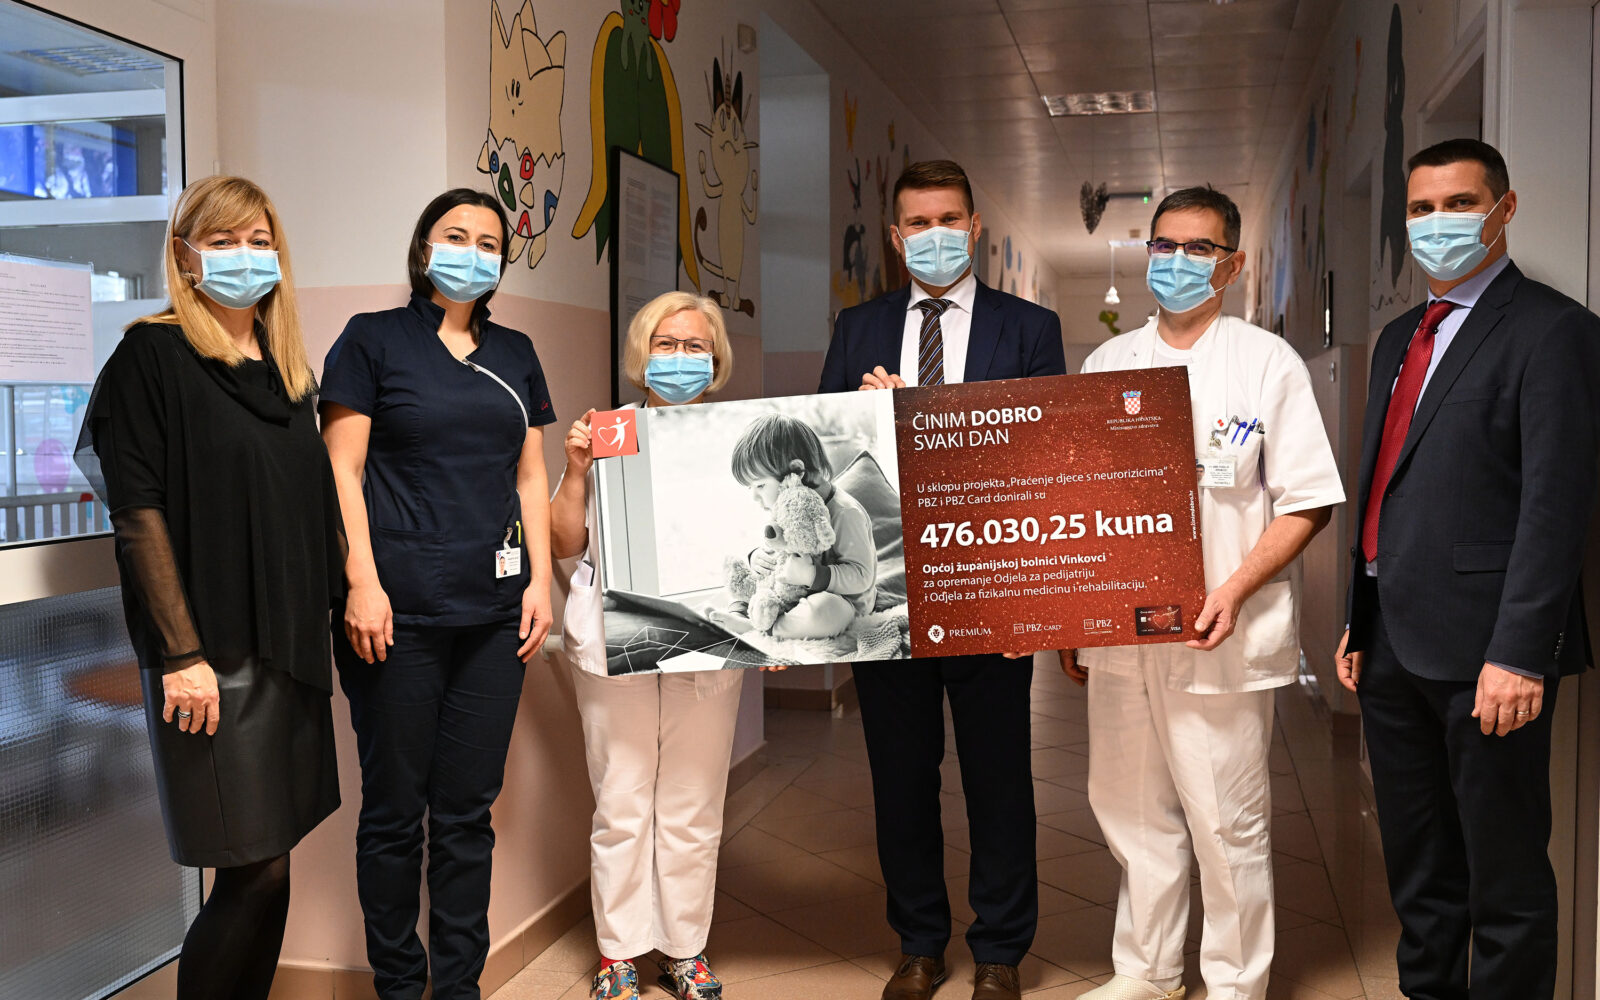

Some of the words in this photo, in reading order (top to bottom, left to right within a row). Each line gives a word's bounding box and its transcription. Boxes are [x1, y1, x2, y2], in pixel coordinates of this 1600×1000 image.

[912, 411, 966, 431] ČINIM
[971, 405, 1042, 427] DOBRO
[914, 431, 964, 451] SVAKI
[969, 428, 1009, 447] DAN
[917, 484, 925, 493] U
[927, 482, 961, 493] sklopu
[963, 479, 1005, 492] projekta
[1007, 475, 1054, 488] „Praćenje
[1056, 473, 1084, 485] djece
[918, 497, 938, 508] PBZ
[945, 495, 965, 506] PBZ
[967, 493, 991, 504] Card
[993, 490, 1032, 503] donirali
[1034, 491, 1046, 500] su
[920, 514, 1086, 548] 476.030,25
[1095, 510, 1173, 537] kuna
[922, 562, 954, 575] Općoj
[956, 558, 1018, 573] županijskoj
[1021, 555, 1058, 567] bolnici
[1059, 552, 1106, 565] Vinkovci
[923, 580, 935, 588] za
[937, 575, 992, 589] opremanje
[994, 572, 1027, 585] Odjela
[1029, 573, 1041, 581] za
[1043, 568, 1095, 582] pedijatriju
[930, 591, 963, 603] Odjela
[965, 592, 976, 600] za
[978, 588, 1020, 599] fizikalnu
[1023, 585, 1071, 596] medicinu
[1078, 579, 1147, 592] rehabilitaciju.
[949, 628, 992, 637] PREMIUM
[1026, 623, 1042, 632] PBZ
[1096, 619, 1112, 628] PBZ
